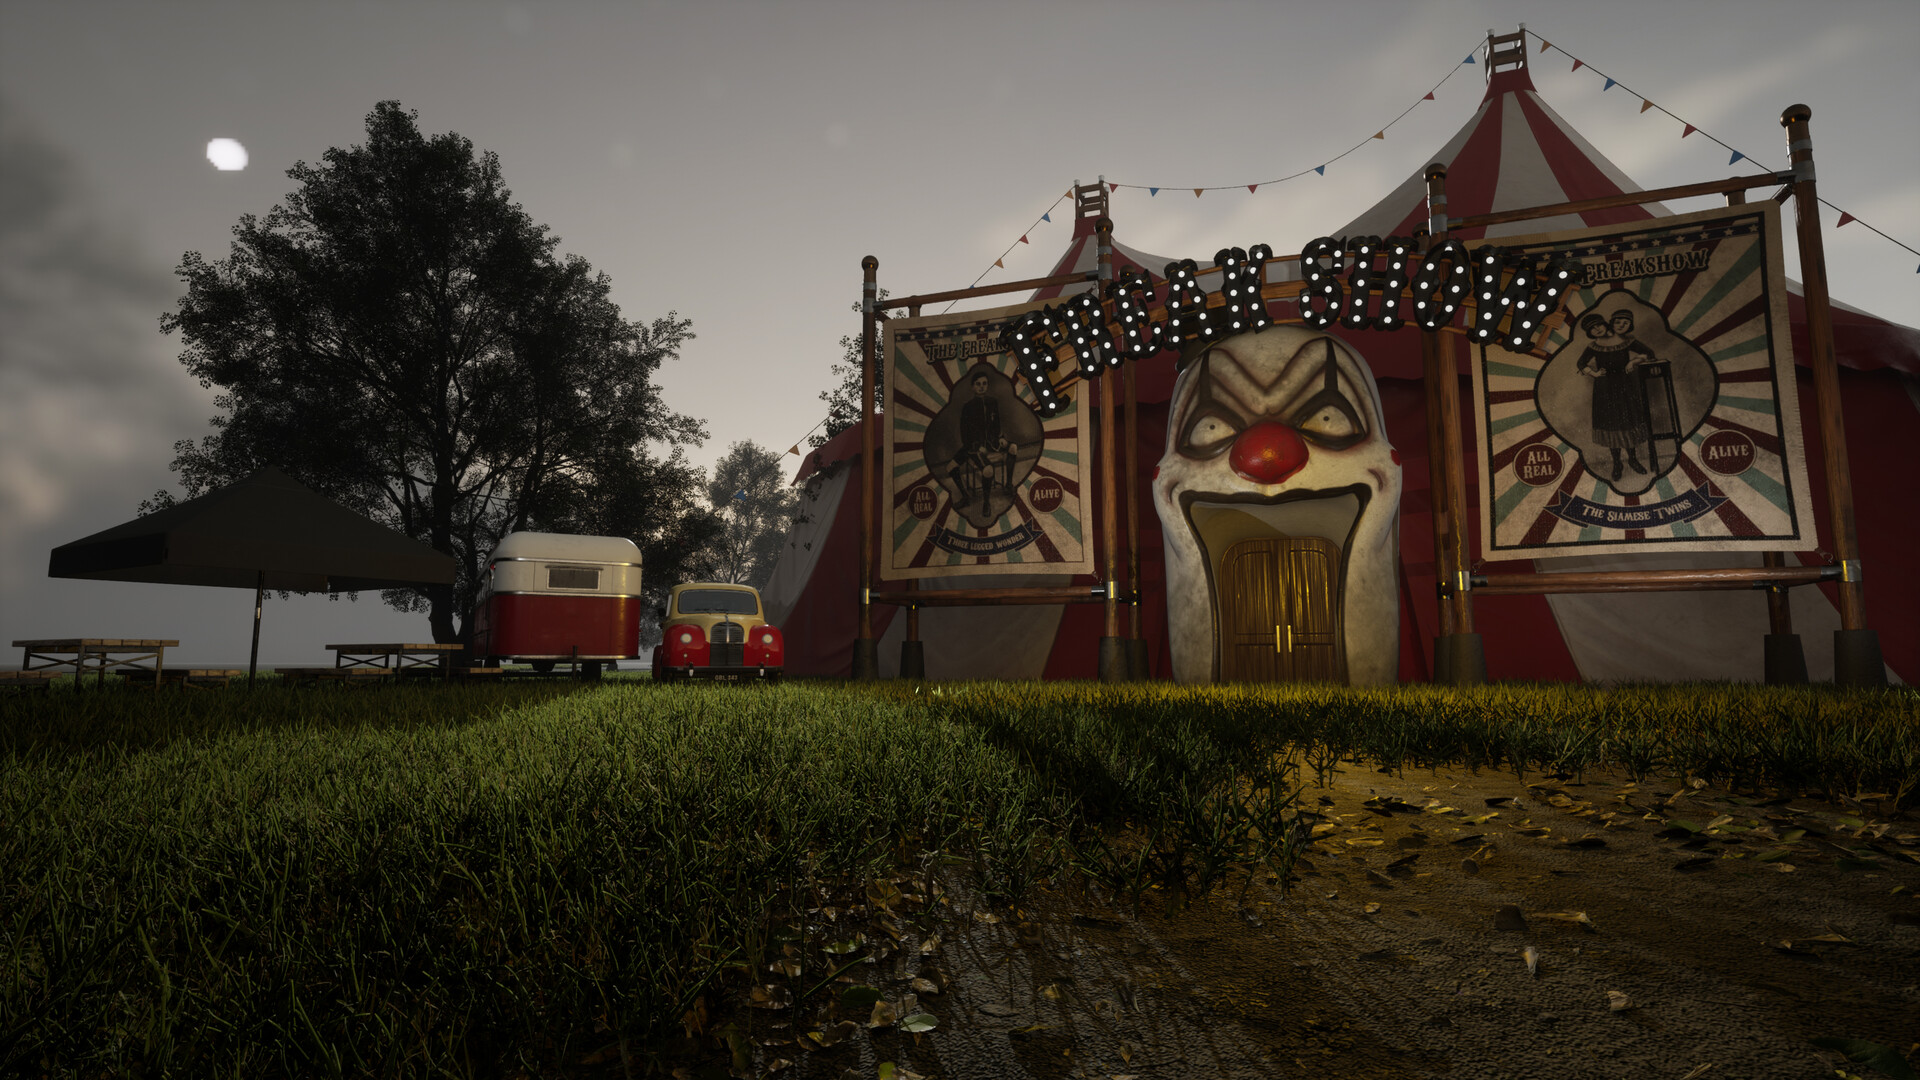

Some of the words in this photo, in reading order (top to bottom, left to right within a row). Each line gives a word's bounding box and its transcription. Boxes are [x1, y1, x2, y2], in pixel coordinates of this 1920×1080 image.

[1580, 248, 1711, 289] FREAKSHOW
[1000, 243, 1274, 418] FREAK
[1299, 235, 1586, 353] SHOW
[925, 343, 957, 364] THE
[1527, 450, 1551, 465] ALL
[1707, 444, 1749, 460] ALIVE
[1523, 463, 1556, 479] REAL
[915, 491, 930, 503] ALL
[1033, 488, 1060, 501] ALIVE
[913, 502, 933, 514] REAL
[1582, 504, 1604, 519] THE
[1607, 510, 1650, 522] SIAMESE
[1653, 499, 1692, 519] TWINS
[947, 536, 968, 549] THREE
[970, 541, 993, 550] LEGGED
[996, 532, 1025, 549] WONDER
